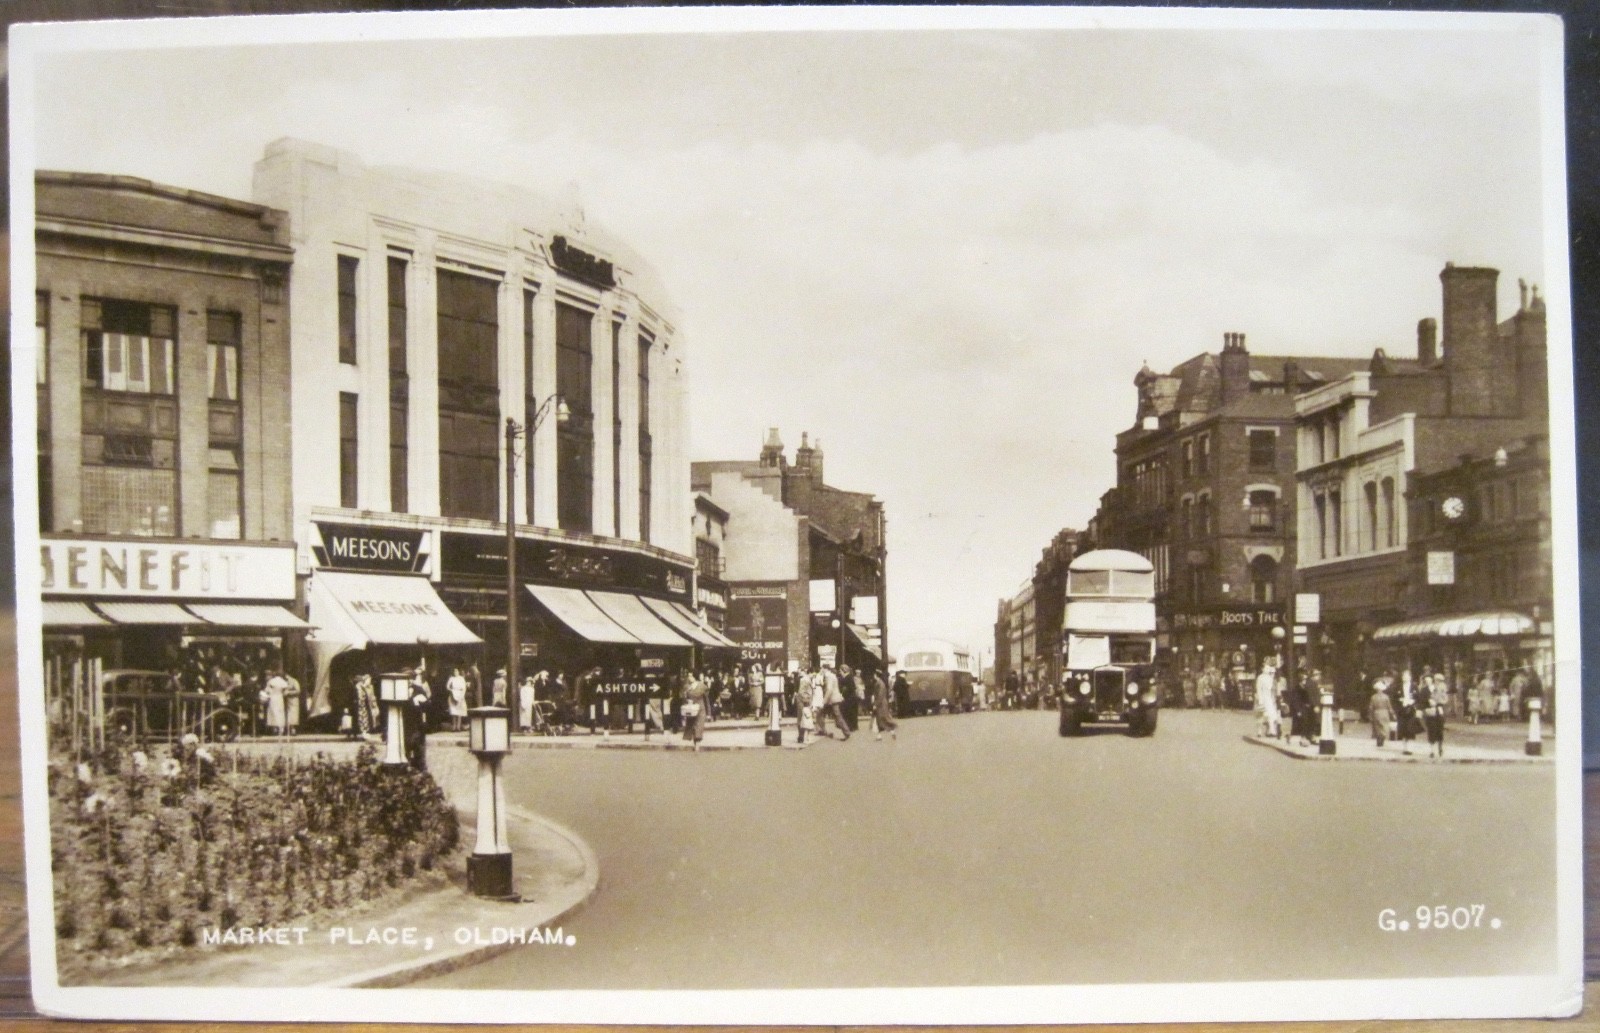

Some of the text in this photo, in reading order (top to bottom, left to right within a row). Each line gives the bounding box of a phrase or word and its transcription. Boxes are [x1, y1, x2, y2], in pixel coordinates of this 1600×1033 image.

[332, 536, 410, 561] MEESONS
[350, 600, 438, 616] MEESONS
[1219, 610, 1254, 625] BOOTS
[1257, 611, 1278, 624] THE
[741, 649, 767, 660] SUI
[595, 683, 646, 693] ASHTON
